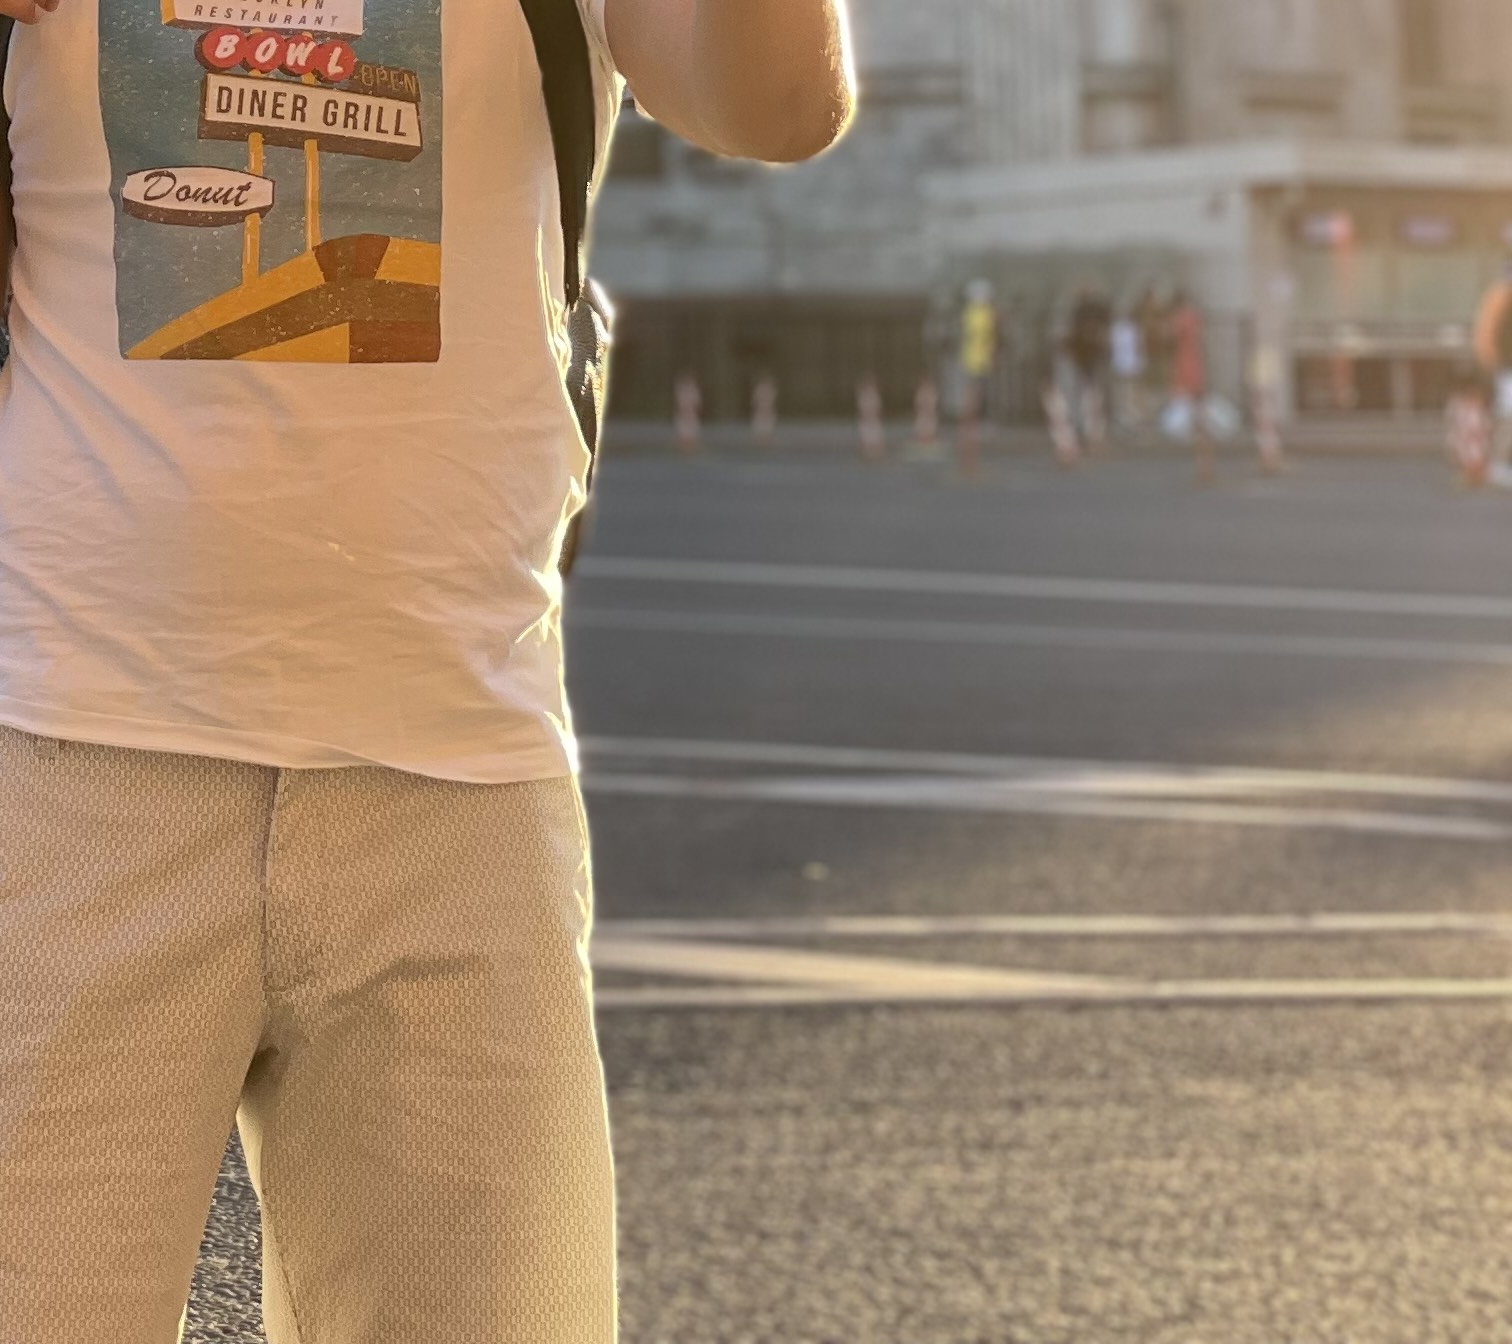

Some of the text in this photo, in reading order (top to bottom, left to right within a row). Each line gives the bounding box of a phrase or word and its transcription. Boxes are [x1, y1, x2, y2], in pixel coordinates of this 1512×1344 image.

[194, 4, 338, 27] RESTAURANT
[215, 34, 343, 75] BOWL
[361, 64, 417, 97] OPEN
[216, 86, 407, 137] DINER GRILL
[144, 170, 252, 207] Donut
